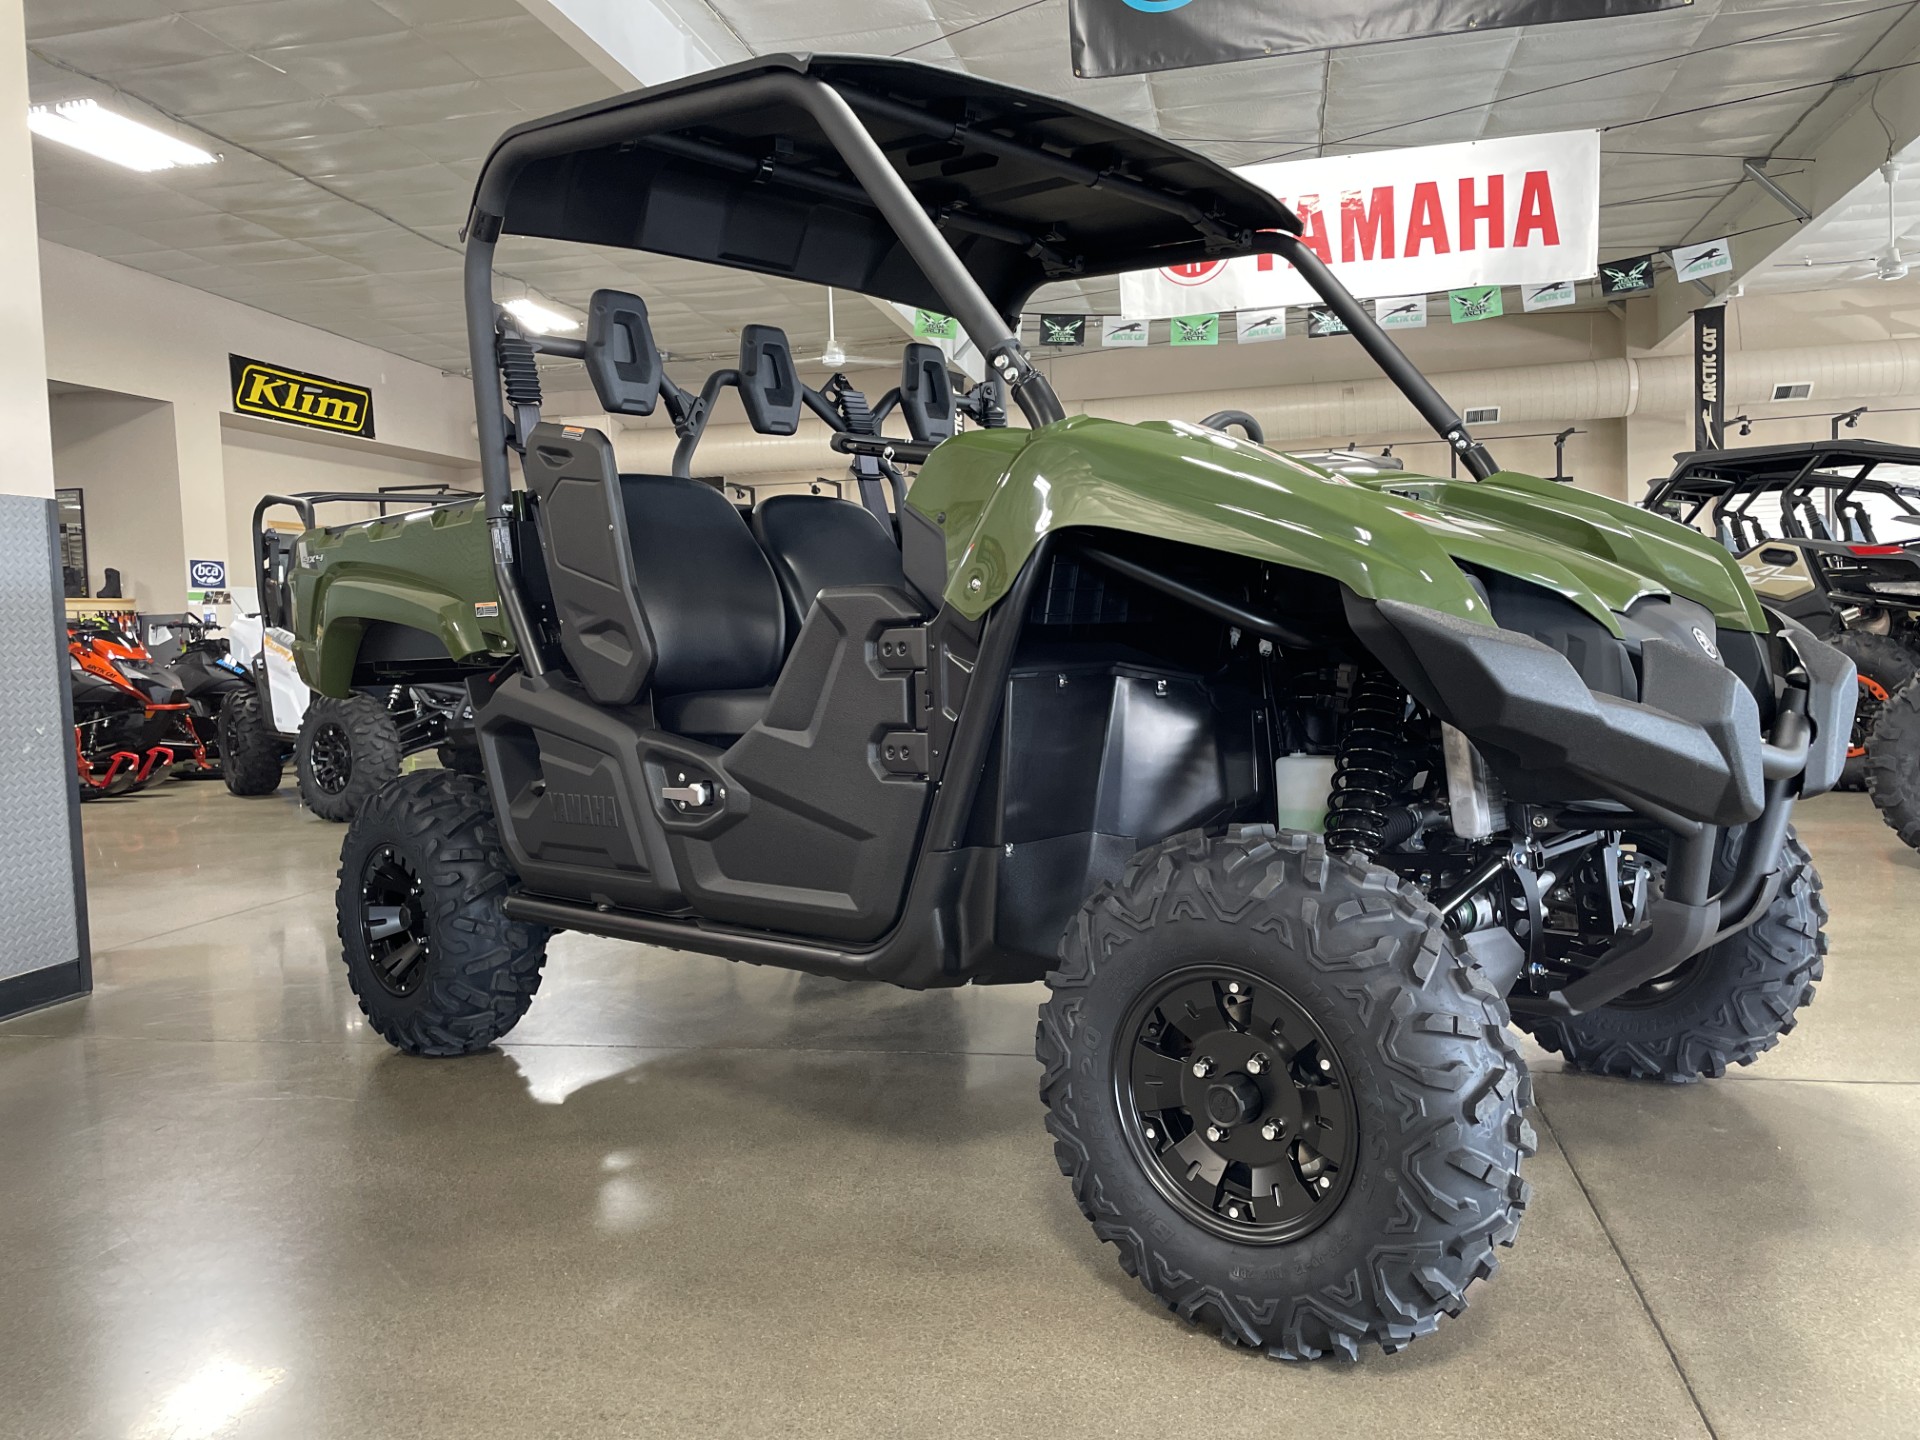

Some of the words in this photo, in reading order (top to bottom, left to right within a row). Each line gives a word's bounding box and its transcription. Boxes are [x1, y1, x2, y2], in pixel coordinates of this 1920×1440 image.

[1688, 261, 1713, 273] ARCTIC
[1715, 257, 1728, 267] CAT
[1534, 292, 1559, 303] ARCTIC
[1559, 289, 1572, 299] CAT
[1385, 315, 1410, 324] ARCTIC
[1411, 313, 1423, 322] CAT
[1111, 333, 1134, 341] ARCTIC
[1135, 333, 1146, 341] CAT
[1247, 328, 1270, 337] ARCTIC
[1271, 326, 1283, 335] CAT
[1703, 325, 1717, 351] CAT
[1703, 354, 1717, 402] ARCTIC
[245, 373, 358, 424] Klim
[198, 563, 219, 576] bca
[87, 663, 106, 676] ARCTIC
[105, 670, 117, 679] CAT
[233, 665, 245, 675] CAT
